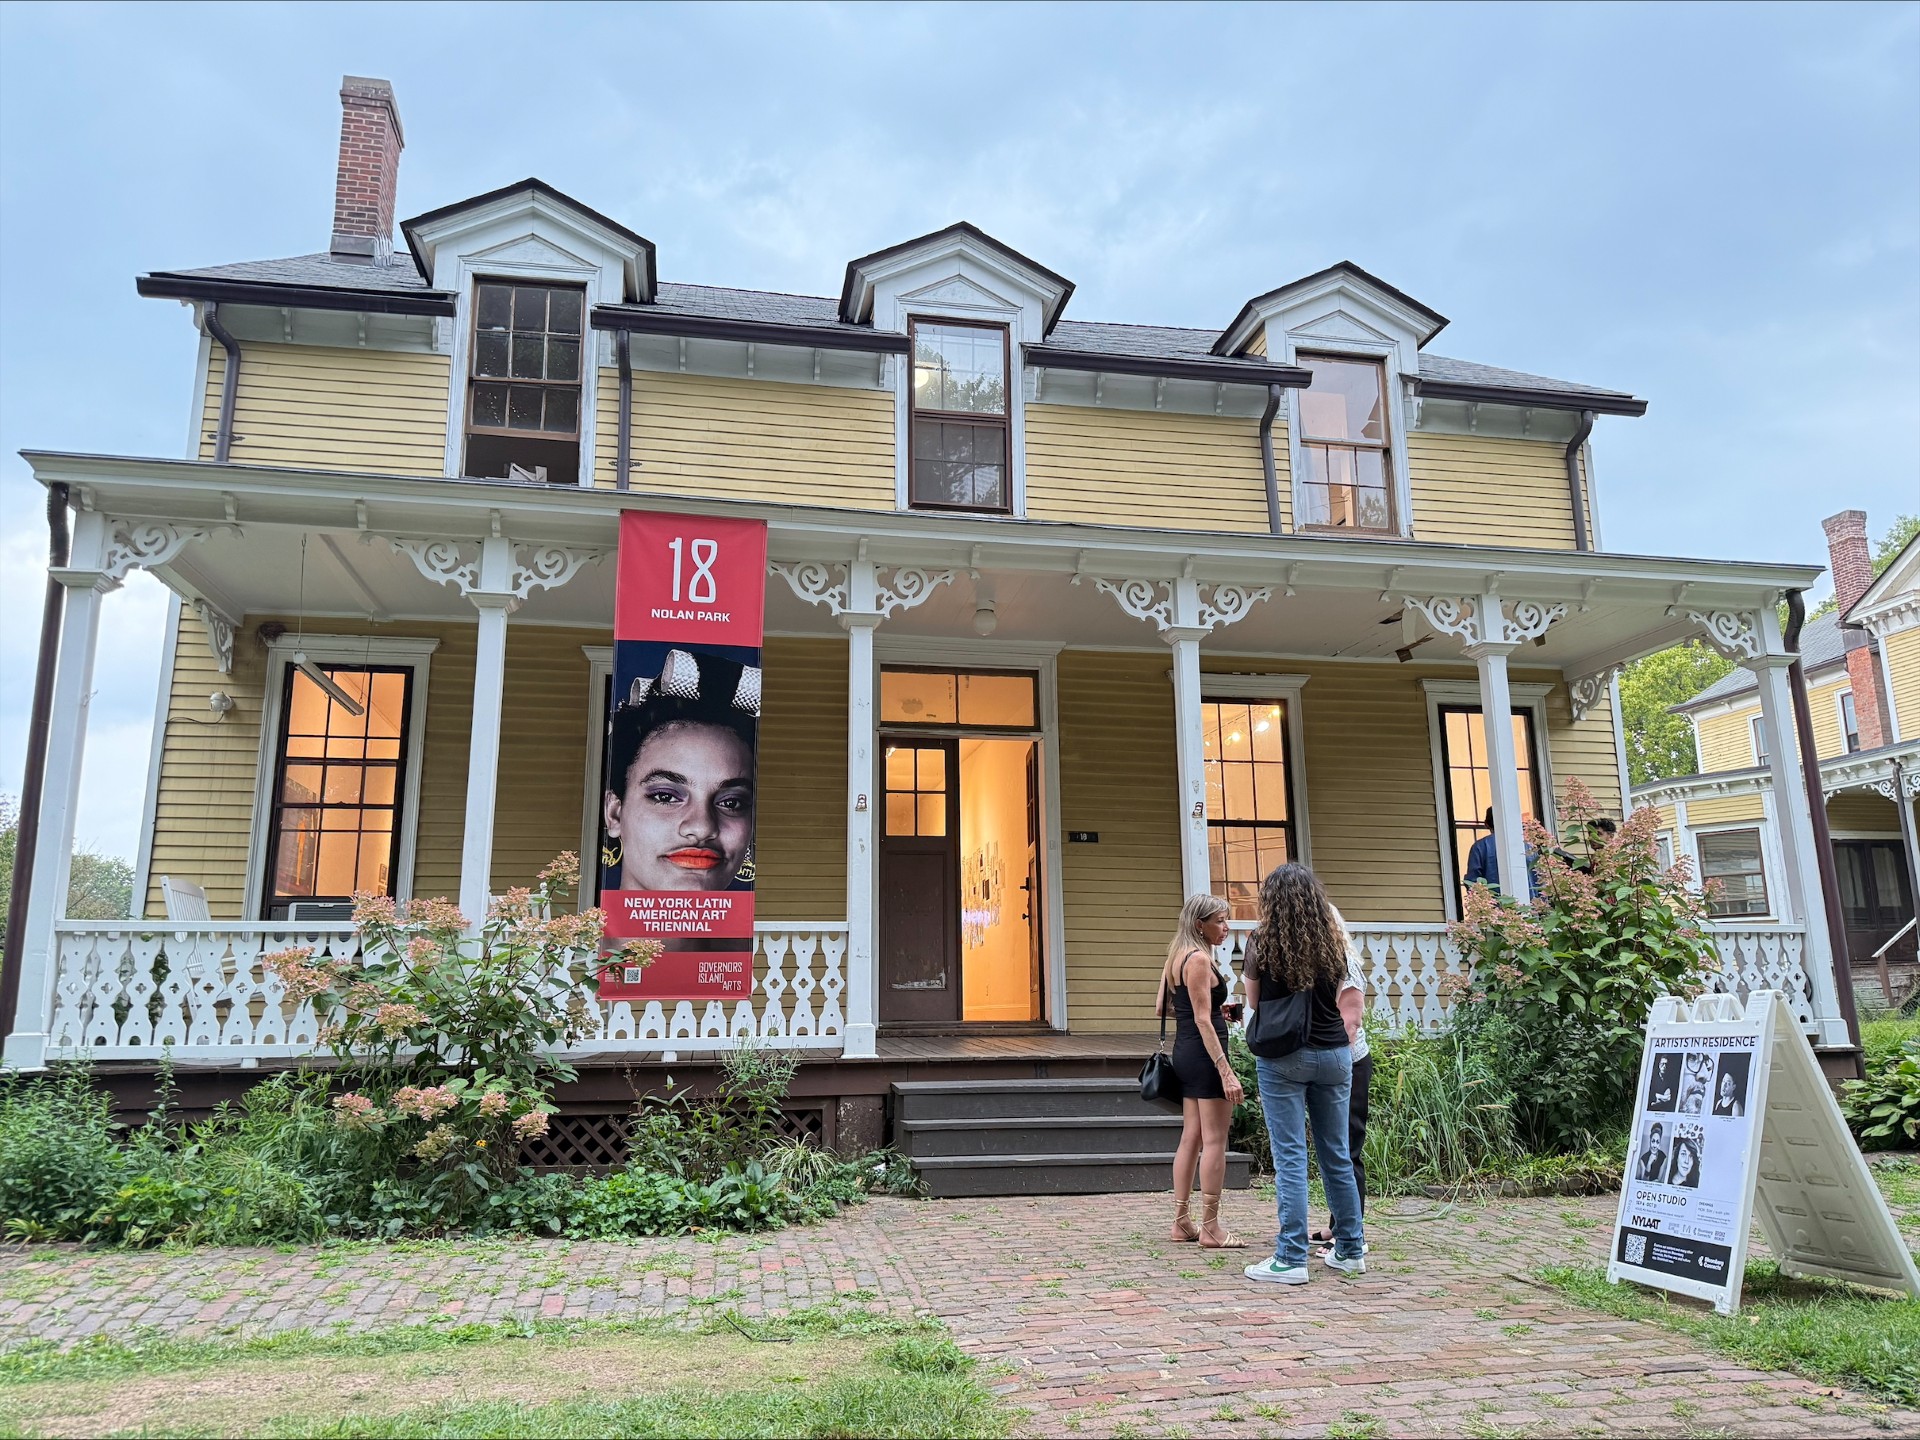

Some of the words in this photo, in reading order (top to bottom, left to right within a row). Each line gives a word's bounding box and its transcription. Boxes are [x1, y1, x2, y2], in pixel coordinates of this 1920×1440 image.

[668, 537, 718, 604] 18
[651, 609, 694, 620] NOLAN
[697, 611, 731, 622] PARK
[624, 897, 655, 908] NEW
[658, 898, 692, 909] YORK
[695, 898, 732, 909] LATIN
[629, 909, 699, 920] AMERICAN
[701, 910, 728, 920] ART
[643, 921, 712, 932] TRIENNIAL
[698, 961, 743, 973] GOVERNORS
[698, 972, 725, 984] ISLAND
[722, 980, 742, 991] ARTS
[1654, 1037, 1689, 1048] ARTISTS
[1690, 1037, 1700, 1048] IN
[1702, 1036, 1756, 1048] RESIDENCE
[1636, 1190, 1657, 1202] OPEN
[1657, 1193, 1687, 1206] STUDIO
